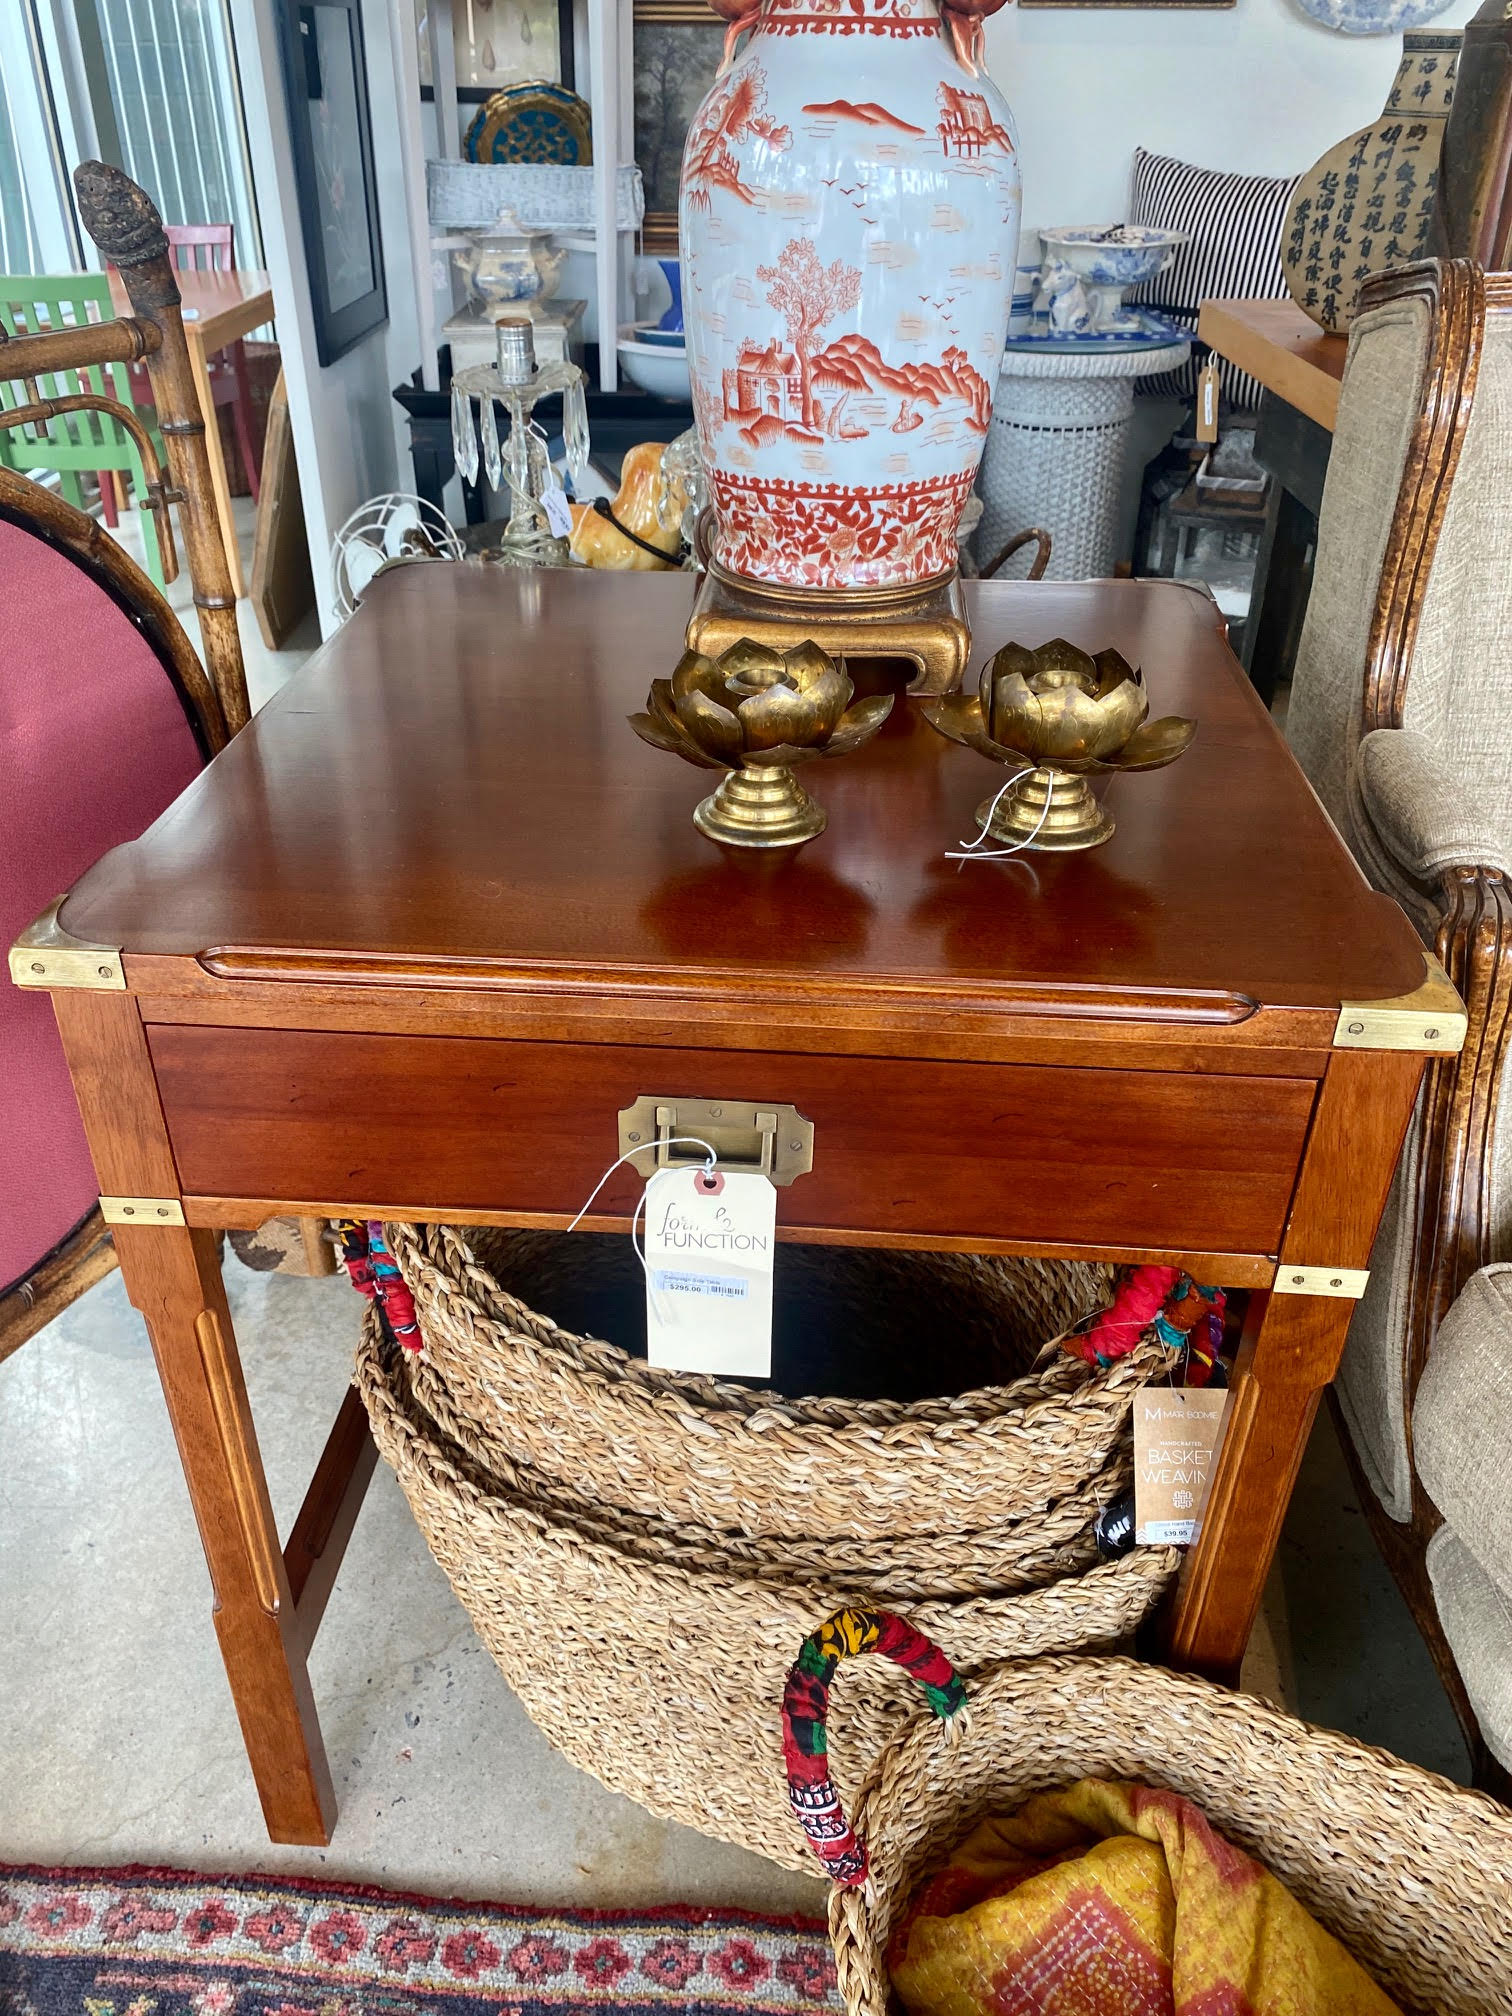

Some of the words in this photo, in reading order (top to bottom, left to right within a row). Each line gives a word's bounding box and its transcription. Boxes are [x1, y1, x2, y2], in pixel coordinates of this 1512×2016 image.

[664, 1232, 767, 1250] FUNCTION
[669, 1284, 702, 1293] $295.00
[1148, 1449, 1213, 1465] BASKET
